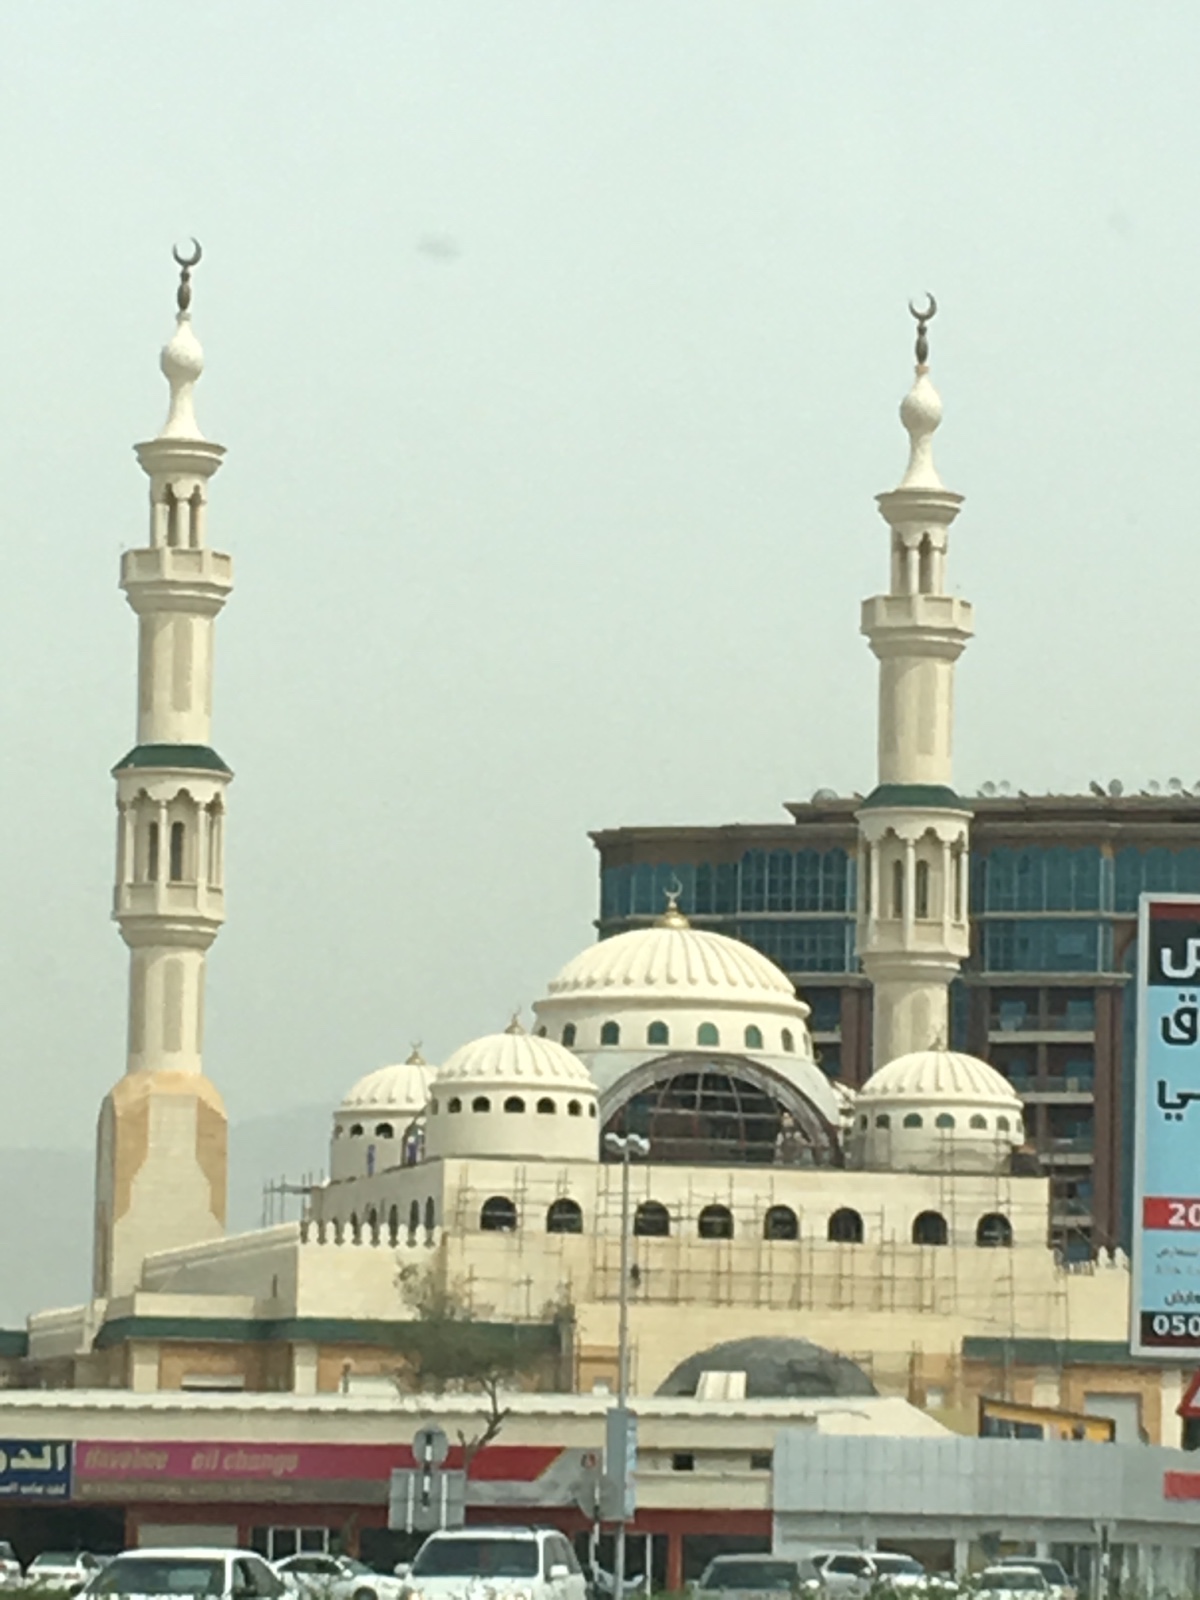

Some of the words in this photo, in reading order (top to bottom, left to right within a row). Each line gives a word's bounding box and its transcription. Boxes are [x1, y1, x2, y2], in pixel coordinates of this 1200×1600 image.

[1152, 1314, 1200, 1337] 050
[191, 1449, 220, 1470] oil
[223, 1450, 299, 1475] change
